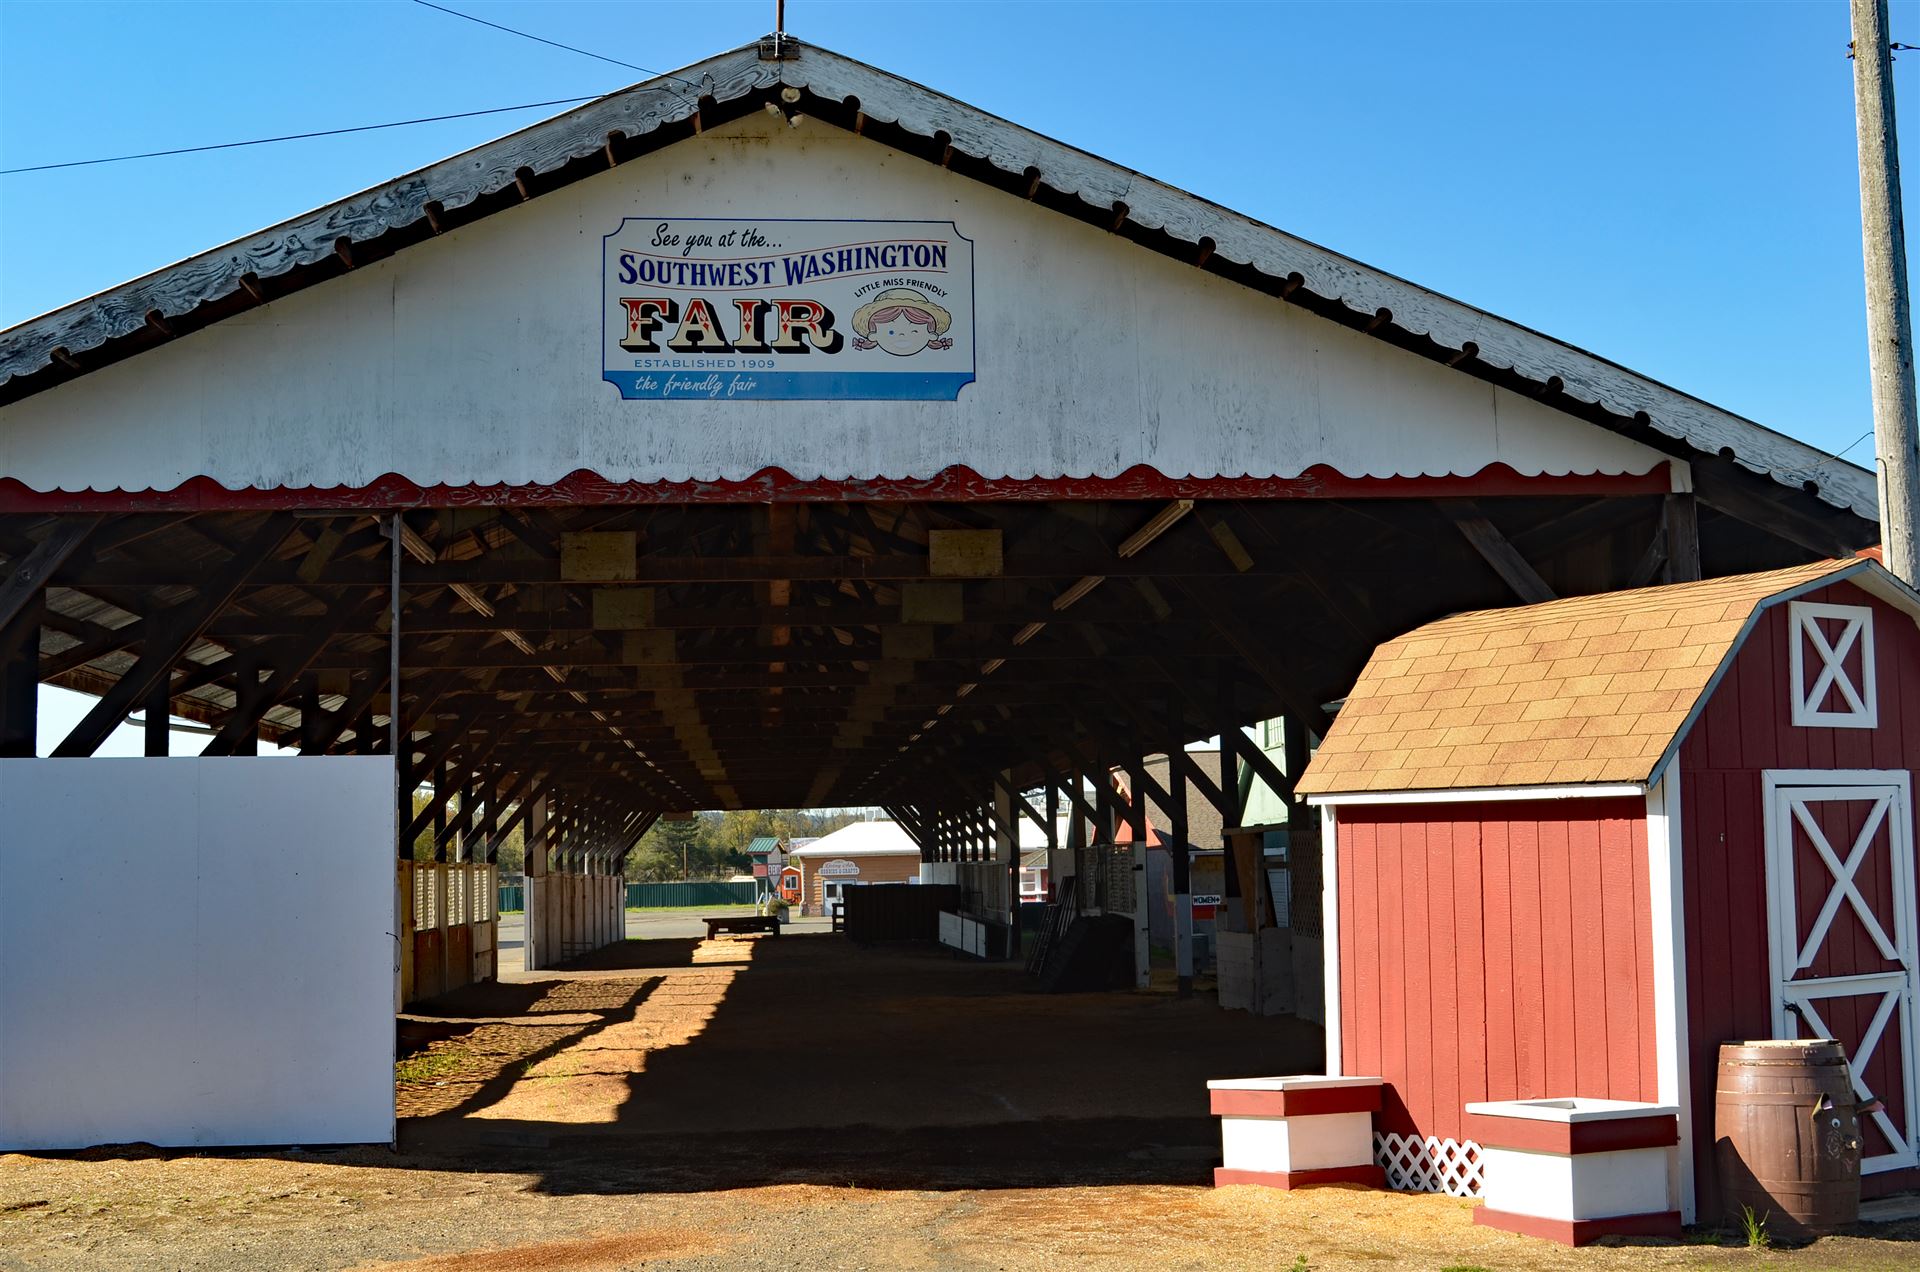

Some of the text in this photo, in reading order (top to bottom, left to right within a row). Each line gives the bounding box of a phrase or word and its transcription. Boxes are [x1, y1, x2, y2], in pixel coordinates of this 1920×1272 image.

[651, 222, 782, 257] See you at the...
[618, 244, 947, 286] SOUTHWEST WASHINGTON
[854, 278, 948, 298] LITTLE MISS FRIENDLY
[619, 297, 844, 354] FAIR
[634, 359, 775, 368] ESTABLISHED 1909
[635, 373, 757, 398] the friendly fair
